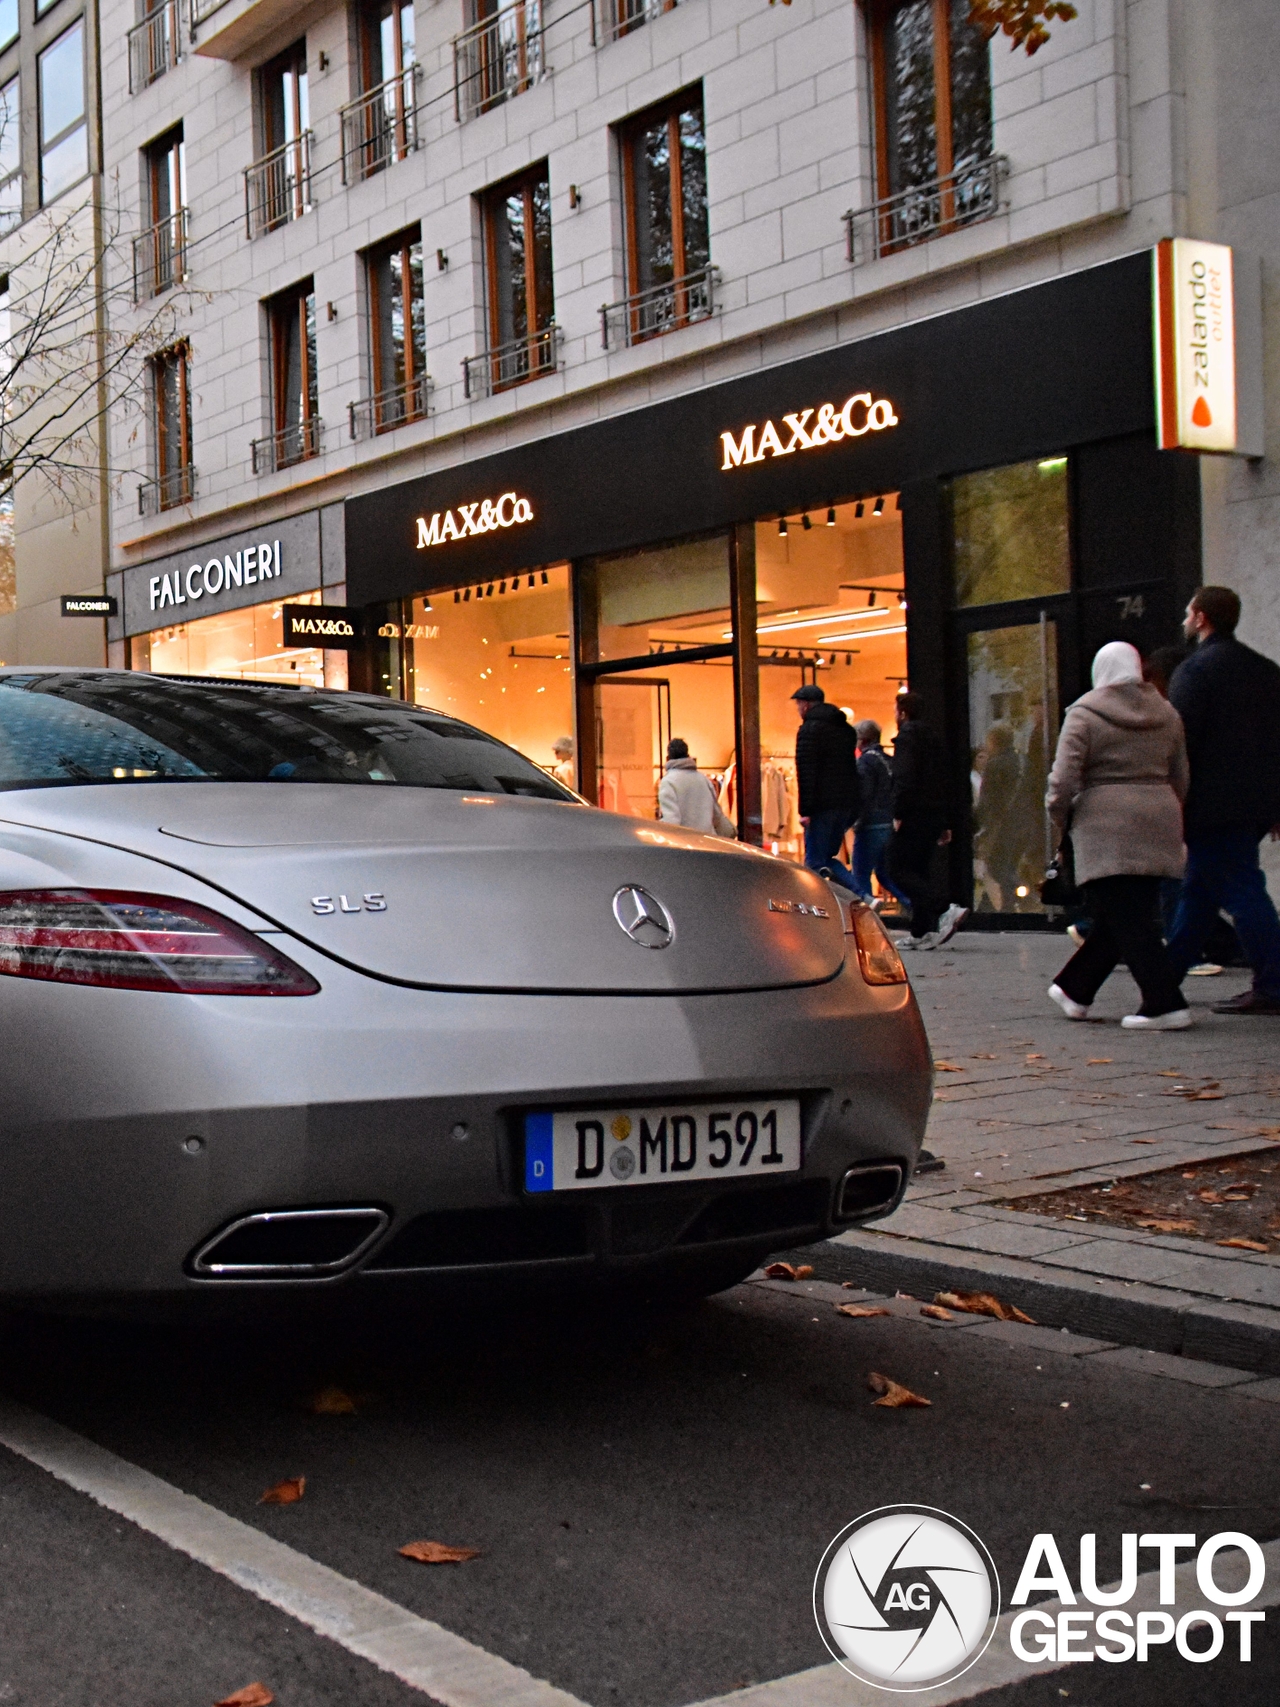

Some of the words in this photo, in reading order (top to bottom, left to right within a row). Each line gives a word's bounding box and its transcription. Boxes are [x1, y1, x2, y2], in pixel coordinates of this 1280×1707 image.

[1189, 260, 1209, 388] zalando
[1208, 267, 1223, 342] outlet
[720, 392, 899, 471] MAX&Co.
[416, 492, 534, 549] MAX&Co.
[65, 601, 110, 611] FALCONERI
[149, 539, 283, 611] FALCONERI
[291, 618, 355, 636] MAX&Co.
[1118, 595, 1146, 619] 74
[311, 893, 387, 915] SLS
[575, 1120, 604, 1179] D
[639, 1114, 697, 1174] MD
[708, 1109, 783, 1168] 591
